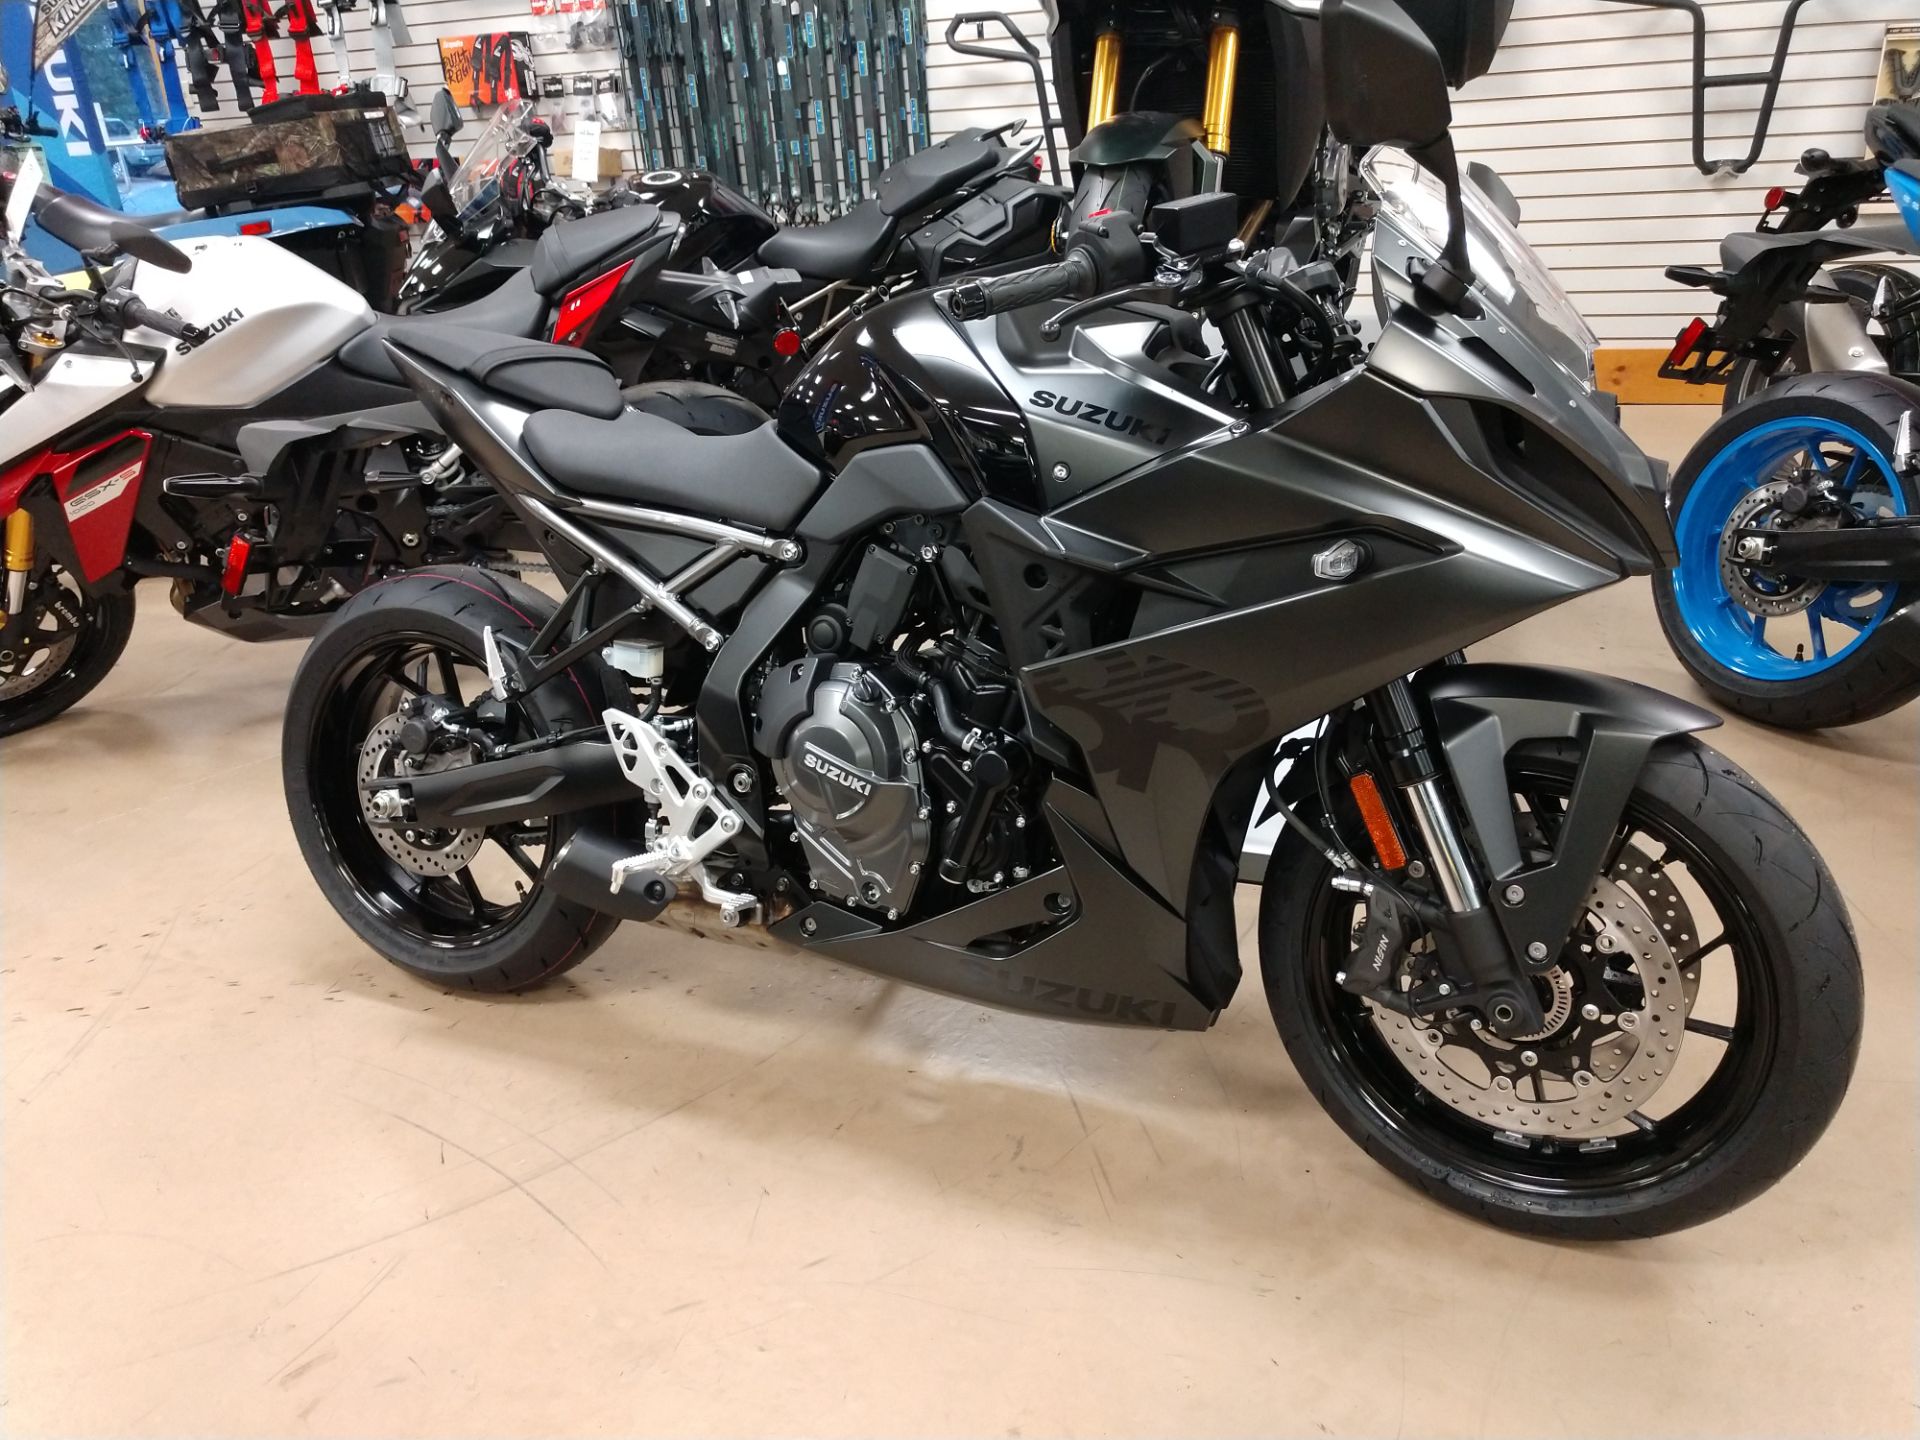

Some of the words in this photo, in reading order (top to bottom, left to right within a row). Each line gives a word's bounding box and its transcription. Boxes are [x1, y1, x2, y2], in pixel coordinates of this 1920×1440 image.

[175, 307, 245, 356] SZUKI
[1029, 390, 1172, 445] SUZUKI
[69, 469, 136, 507] GSX-S
[69, 500, 96, 516] 1000
[54, 600, 80, 628] brembo
[803, 753, 872, 796] SUZUKI
